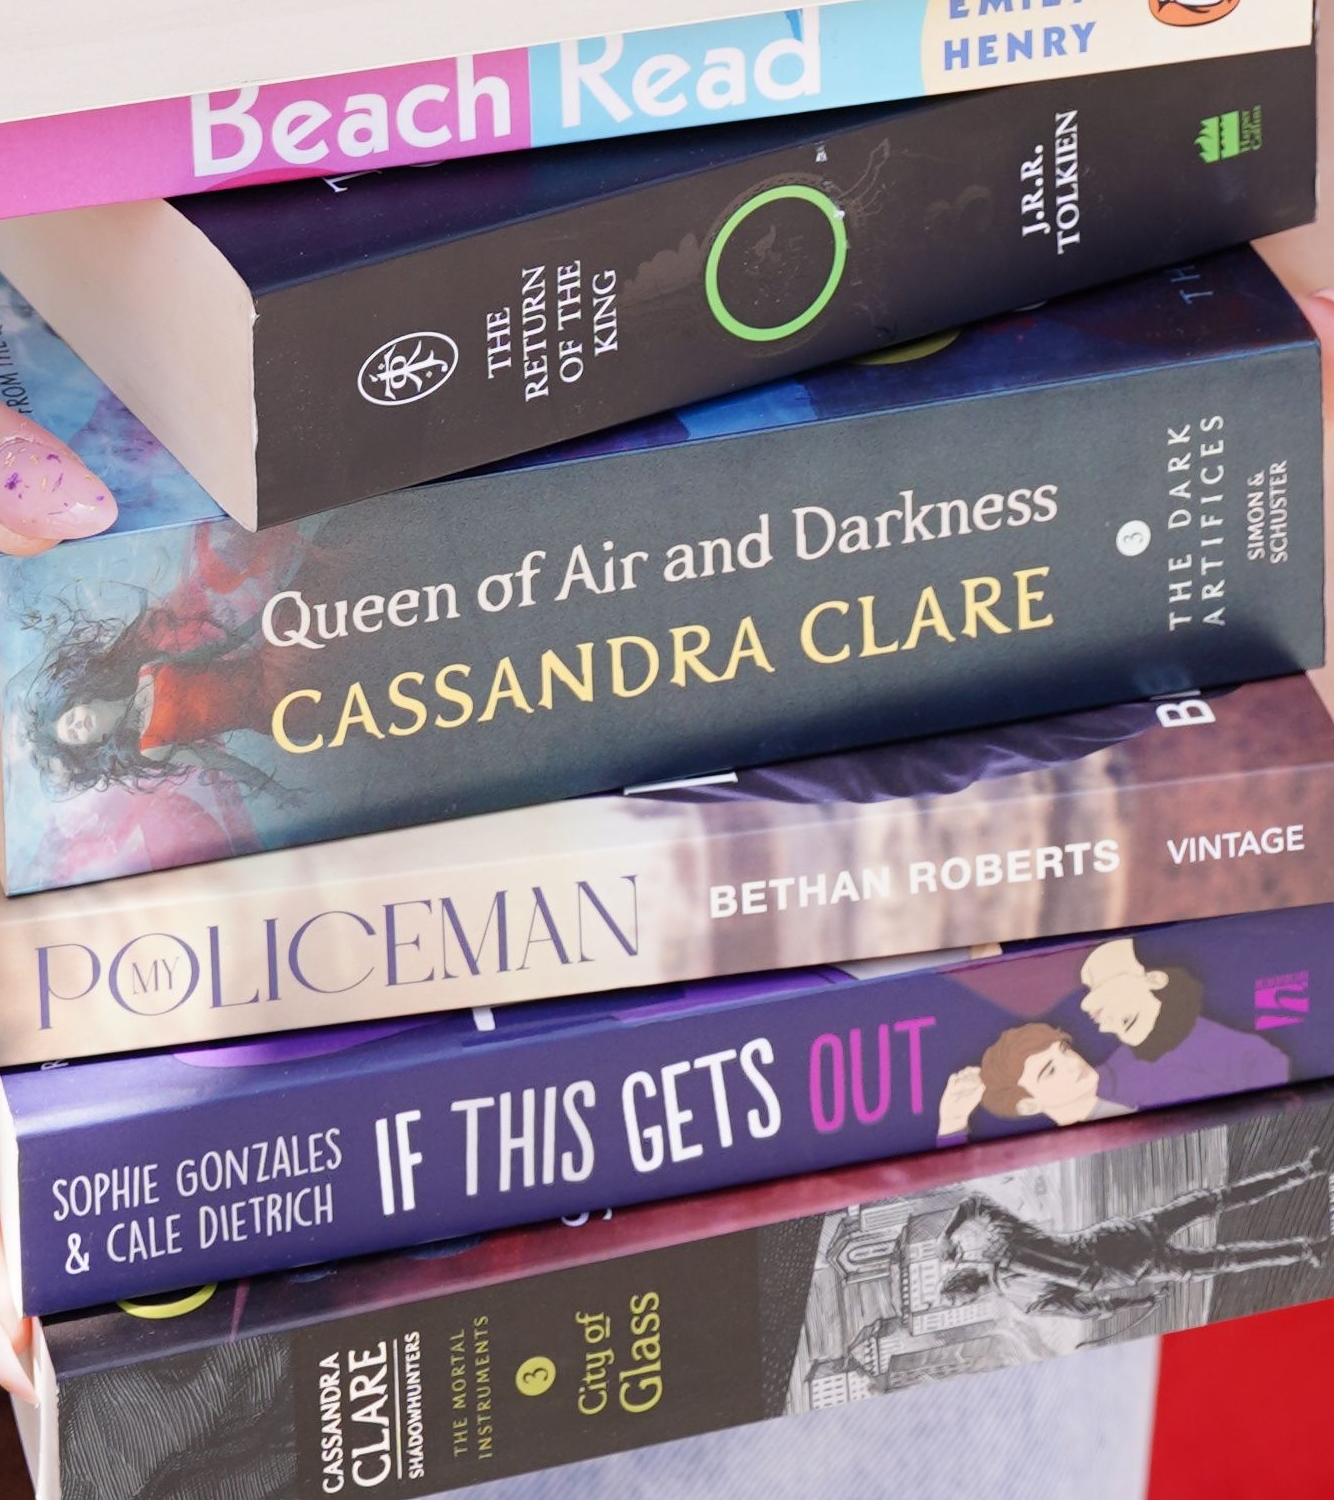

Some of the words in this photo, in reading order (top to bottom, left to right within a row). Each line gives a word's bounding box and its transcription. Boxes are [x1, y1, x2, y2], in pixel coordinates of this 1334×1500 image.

[190, 53, 511, 177] Beach
[559, 5, 822, 129] Read
[943, 21, 1097, 72] HENRY
[1021, 142, 1049, 237] J.R.R.
[1056, 109, 1080, 255] TOLKIEN
[487, 306, 511, 379] THE
[522, 264, 549, 402] RETURN
[557, 260, 581, 332] THE
[593, 269, 618, 356] KING
[559, 340, 584, 383] OF
[1168, 423, 1192, 530] DARK
[1200, 415, 1226, 627] ARTIFICES
[1248, 471, 1265, 487] &
[1269, 460, 1288, 564] SCHUSTER
[261, 583, 460, 650] Queen
[476, 549, 547, 612] of
[556, 541, 649, 601] Air
[663, 514, 773, 582] and
[792, 484, 1059, 562] Darkness
[1248, 492, 1265, 561] SIMON
[1168, 553, 1193, 631] THE
[270, 616, 775, 754] CASSANDRA
[800, 566, 1055, 664] CLARE
[36, 875, 640, 1031] POLICEMAN
[709, 866, 892, 920] BETHAN
[908, 839, 1121, 896] ROBERTS
[1167, 824, 1306, 865] VINTAGE
[131, 956, 181, 996] MY
[375, 1109, 423, 1216] IF
[450, 1080, 595, 1198] THIS
[622, 1036, 783, 1174] GETS
[808, 1016, 937, 1134] OUT
[52, 1163, 158, 1222] SOPHIE
[176, 1127, 343, 1198] GONZALES
[65, 1233, 90, 1275] &
[106, 1214, 182, 1264] CALE
[198, 1183, 334, 1246] DIETRICH
[450, 1329, 468, 1411] MORTAL
[575, 1311, 606, 1344] of
[619, 1291, 663, 1414] Glass
[319, 1352, 345, 1494] CASSANDRA
[348, 1341, 392, 1488] CLARE
[405, 1331, 425, 1480] SHADOWHUNTERS
[474, 1315, 493, 1460] INSTRUMENTS
[578, 1348, 614, 1416] City
[454, 1416, 469, 1458] THE
